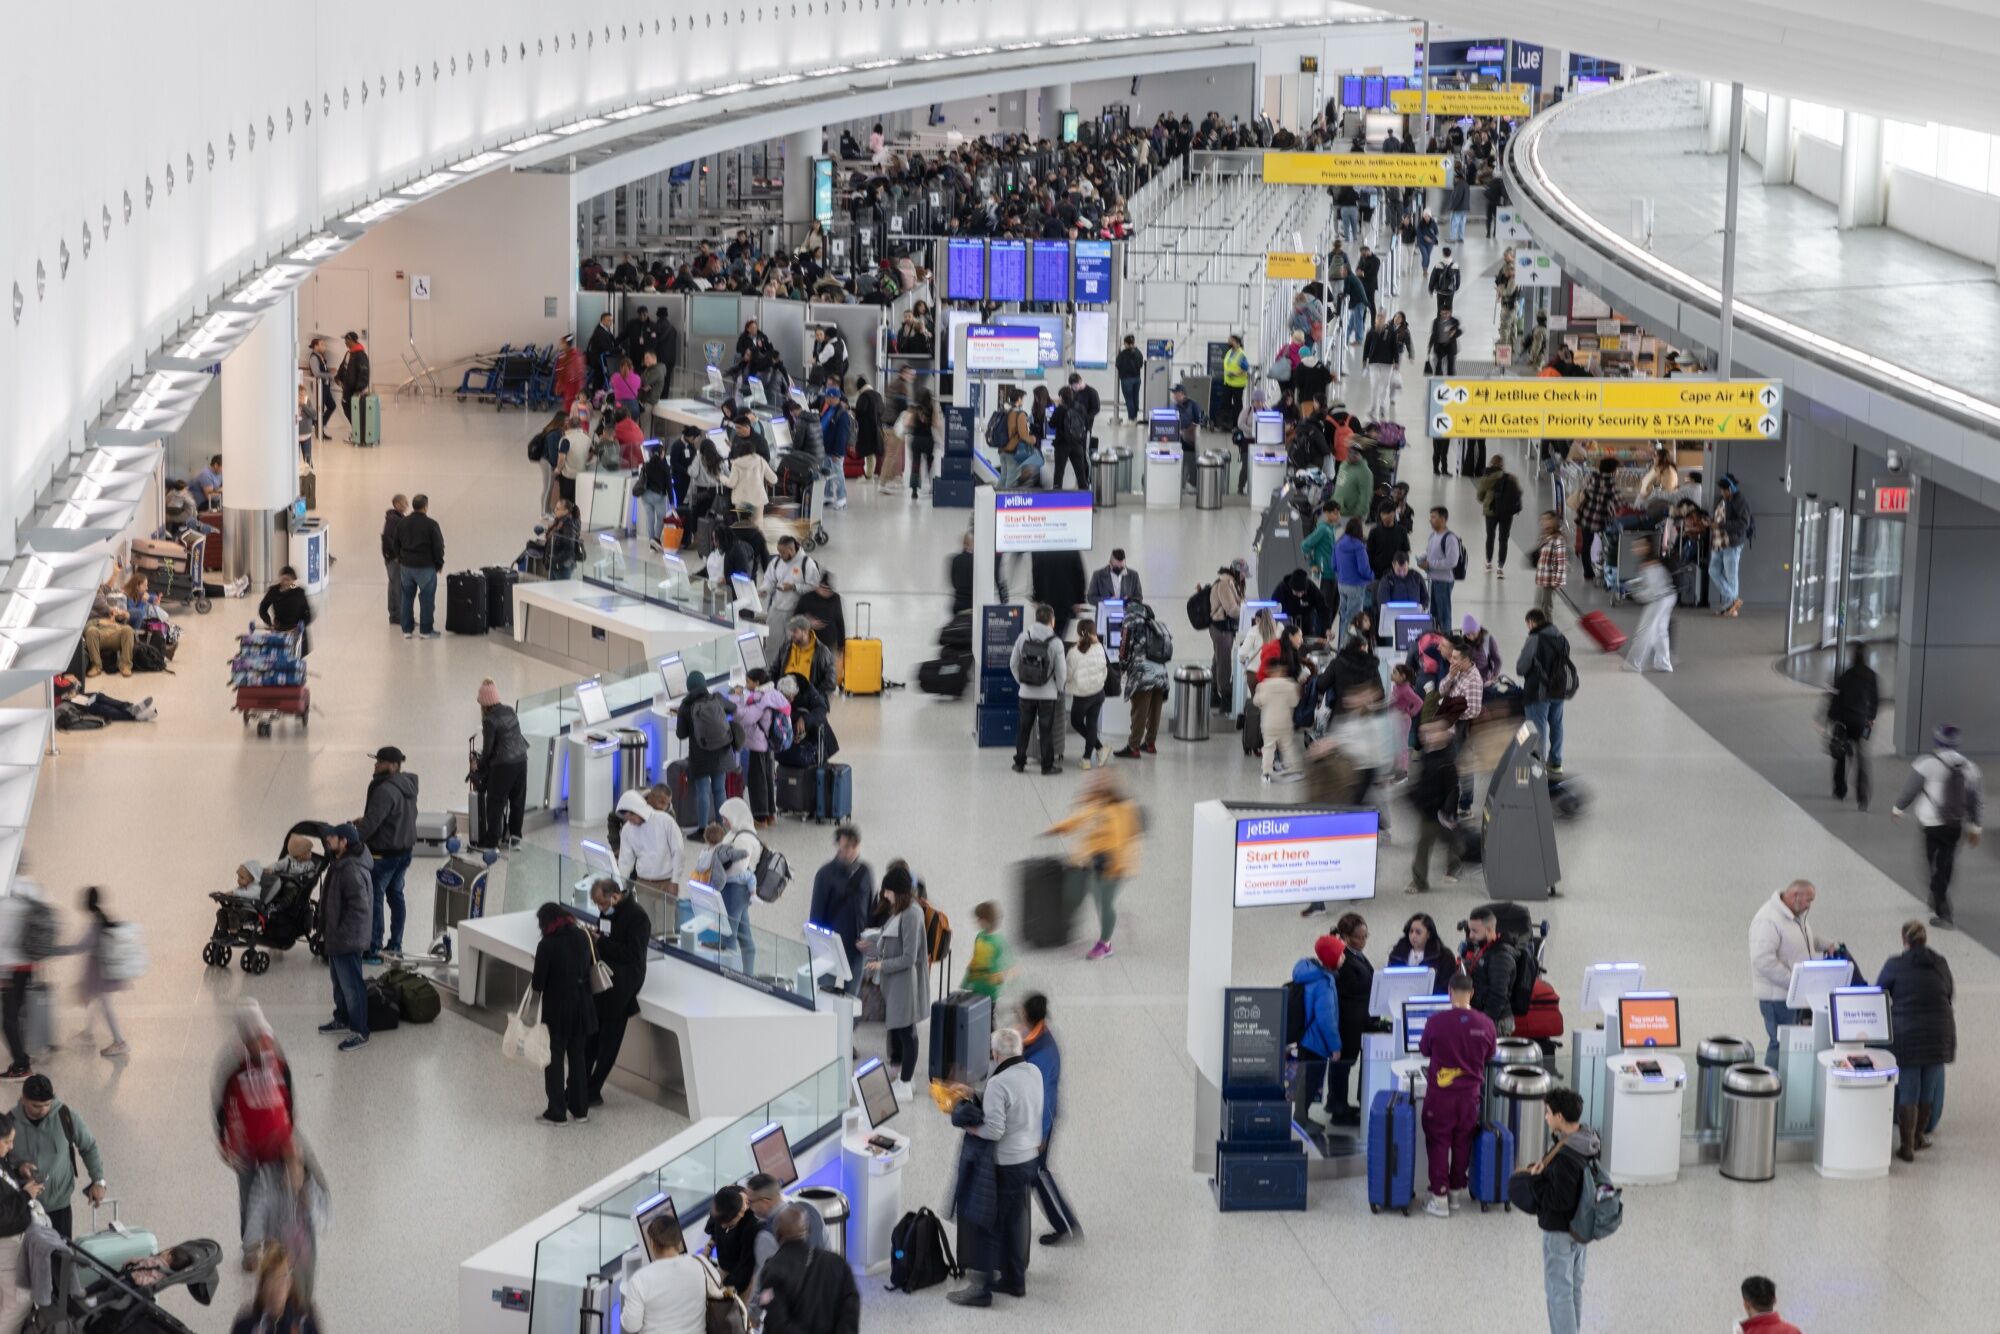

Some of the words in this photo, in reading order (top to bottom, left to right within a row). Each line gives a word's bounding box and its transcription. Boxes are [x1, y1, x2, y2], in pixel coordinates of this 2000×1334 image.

[1321, 171, 1347, 179] Priority
[1350, 172, 1378, 180] Security
[1494, 389, 1540, 401] JetBlue
[1544, 389, 1597, 401] Check-in
[1680, 390, 1711, 404] Cape
[1716, 390, 1734, 401] Air
[1480, 414, 1497, 425] All
[1502, 414, 1539, 425] Gates
[1548, 415, 1594, 428] Priority
[1598, 414, 1648, 428] Security
[1653, 415, 1662, 425] &
[1666, 415, 1690, 425] TSA
[1695, 415, 1714, 426] Pre
[1004, 496, 1033, 508] jetBlue
[1879, 488, 1908, 511] EXIT
[1247, 820, 1289, 839] jetBlue
[1246, 849, 1279, 862] Start
[1282, 849, 1310, 860] here
